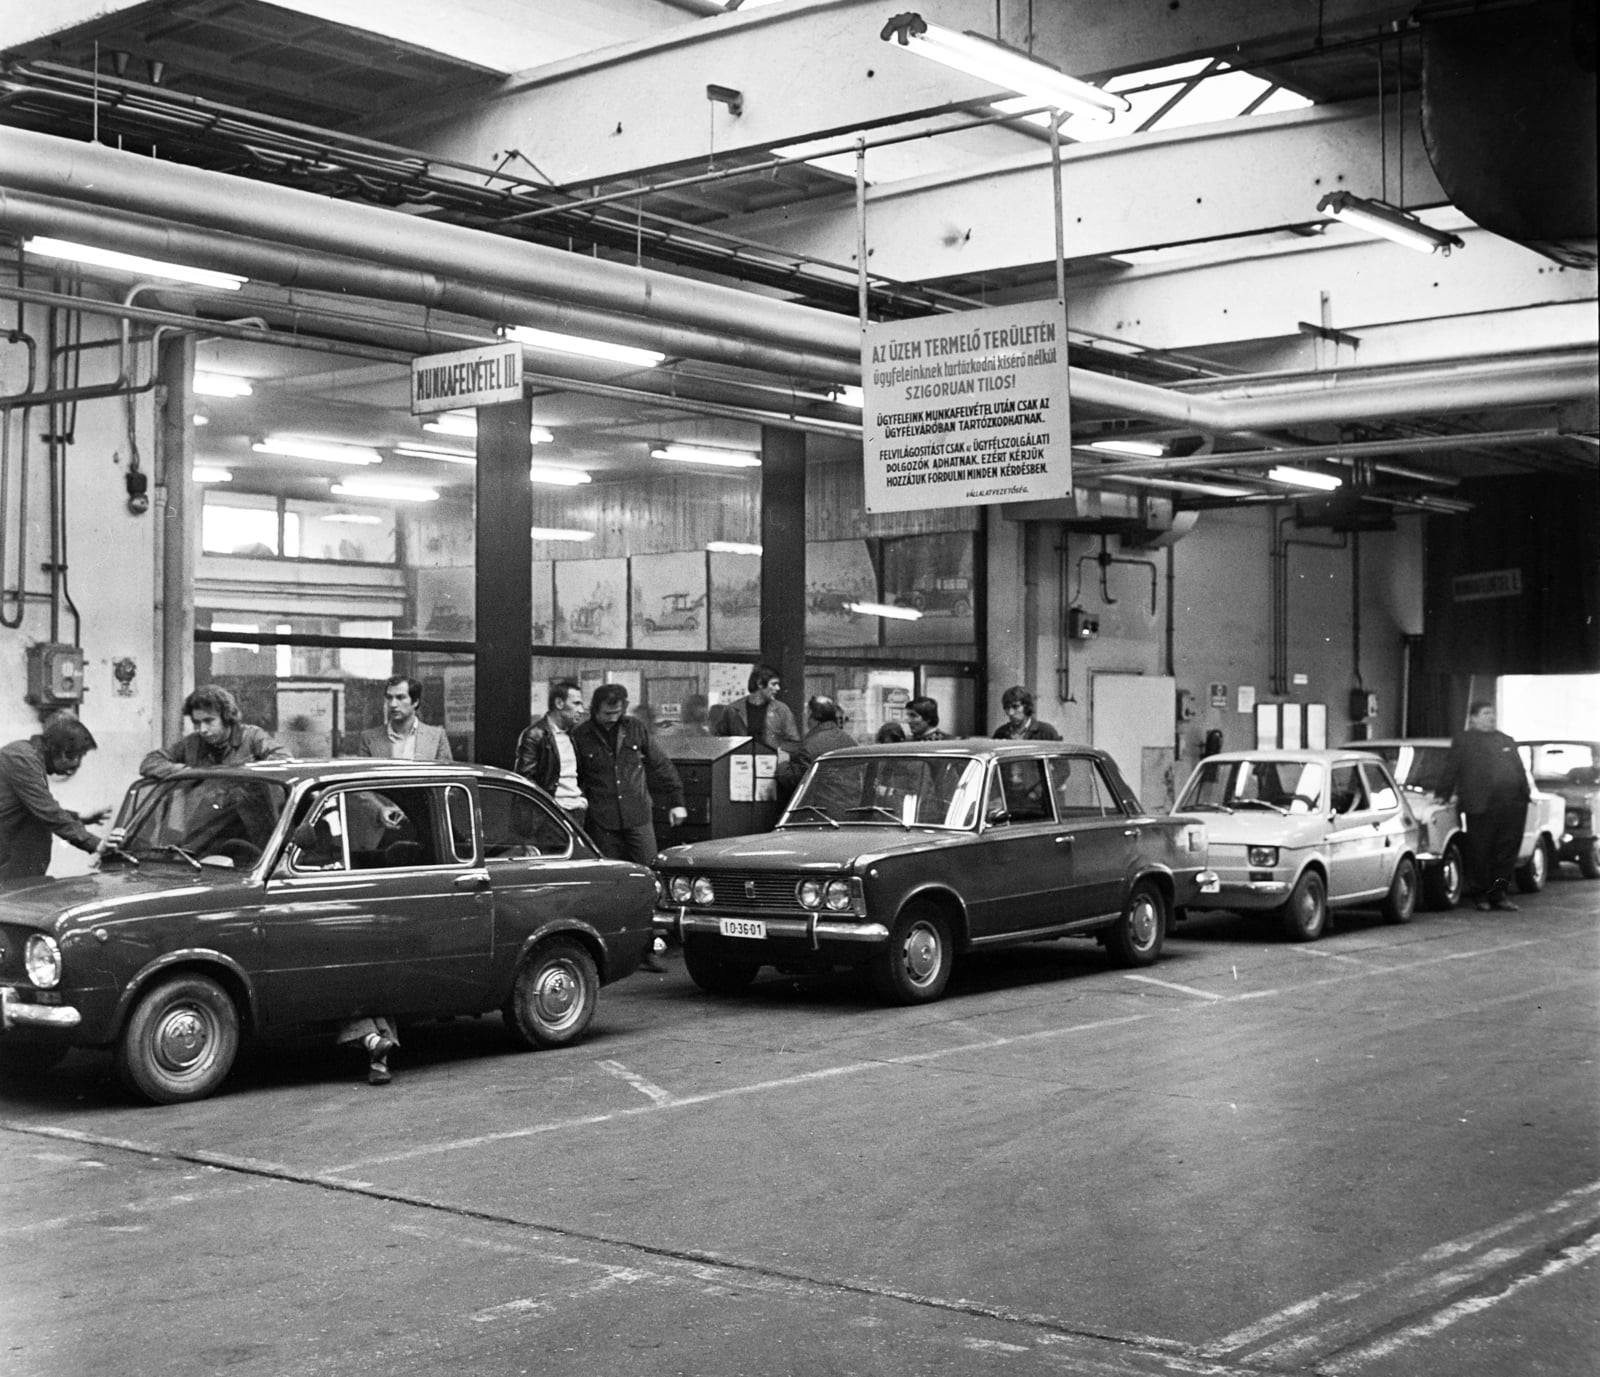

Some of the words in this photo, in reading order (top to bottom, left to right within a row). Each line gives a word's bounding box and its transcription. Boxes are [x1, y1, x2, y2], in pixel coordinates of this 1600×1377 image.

[873, 344, 886, 363] AZ
[889, 339, 922, 361] ÜZEM
[924, 328, 981, 357] TERMELŐ
[983, 320, 1056, 349] TERÜLETÉN
[417, 356, 502, 400] MUNKAFELVÉTEL
[873, 364, 943, 388] ügyfeleinknek
[944, 356, 996, 376] tartózkodni
[1027, 347, 1057, 367] nélkül
[905, 378, 975, 400] SZIGORUAN
[978, 374, 1016, 392] TILOS!
[877, 410, 924, 426] ÜGYFELEINK
[925, 402, 993, 421] MUNKAFELVÉTEL
[993, 398, 1016, 414] UTÁN
[1017, 399, 1038, 411] CSAK
[1039, 398, 1050, 409] AZ
[885, 420, 956, 438] ÜGYFÉLVÁRÓBAN
[958, 412, 1046, 431] TARTÓZKODHATNAK.
[945, 442, 965, 454] CSAK
[973, 432, 1050, 452] ÜGYFÉLSZOLGÁLATI
[886, 457, 930, 473] DOLGOZÓK
[932, 454, 979, 469] ADHATNAK.
[981, 450, 1007, 464] EZÉRT
[1009, 446, 1044, 461] KÉRJÜK
[886, 472, 927, 487] HOZZÁJUK
[927, 469, 965, 483] FORDULNI
[967, 466, 998, 480] MINDEN
[1000, 462, 1048, 477] KÉRDÉSBEN.
